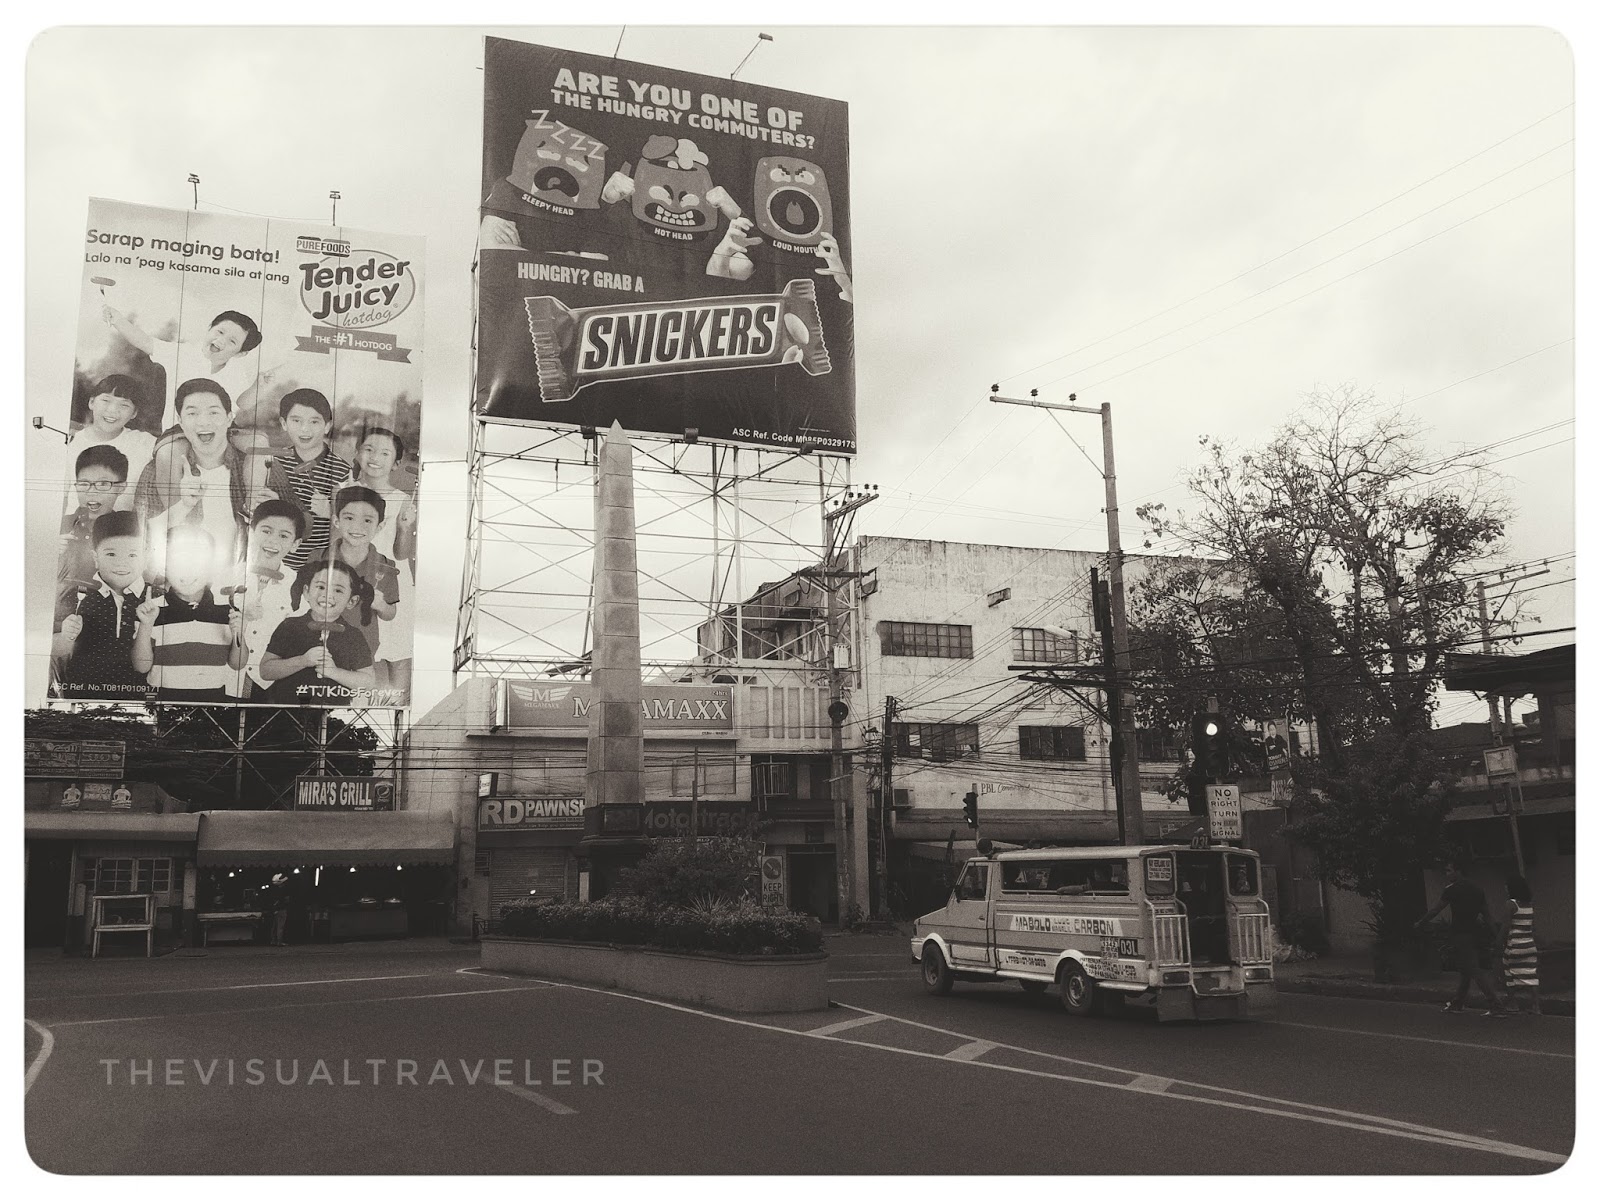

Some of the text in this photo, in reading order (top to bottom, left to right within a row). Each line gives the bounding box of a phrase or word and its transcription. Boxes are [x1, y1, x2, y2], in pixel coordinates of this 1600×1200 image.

[553, 67, 804, 132] ARE YOU ONE OF
[550, 88, 816, 150] THE HUNGRY COMMUTERS?
[521, 193, 574, 217] SLEEPY HEAD
[654, 227, 693, 241] HOT HEAD
[86, 228, 281, 264] Sarap maging bata!
[296, 239, 351, 256] PUREFOODS
[772, 239, 793, 252] LOUD
[85, 252, 111, 266] Lalo
[114, 255, 132, 265] na
[168, 257, 221, 276] kasama
[224, 266, 246, 279] sila
[249, 269, 263, 281] at
[265, 272, 291, 286] ang
[299, 257, 411, 292] Tender
[517, 261, 645, 293] HUNGRY? GRAB A
[312, 282, 401, 320] Juicy
[343, 308, 393, 327] hotdog
[314, 335, 331, 344] THE
[354, 340, 393, 352] HOTDOG
[581, 305, 776, 371] SNICKERS
[732, 427, 751, 438] ASC
[753, 430, 769, 440] Ref.
[771, 432, 793, 443] Code
[49, 682, 68, 691] ASC
[69, 682, 86, 691] Ref.
[532, 688, 551, 702] M
[573, 697, 728, 721] MAMAXX
[299, 781, 372, 806] MIRA'S GRILL
[981, 783, 996, 794] PBL
[1214, 788, 1232, 797] NO
[480, 799, 525, 825] RD
[763, 882, 783, 892] KEEP
[763, 893, 784, 903] RIGHT
[1015, 916, 1051, 932] MABOLO
[1074, 918, 1114, 936] CARBON
[1120, 939, 1139, 956] 03L
